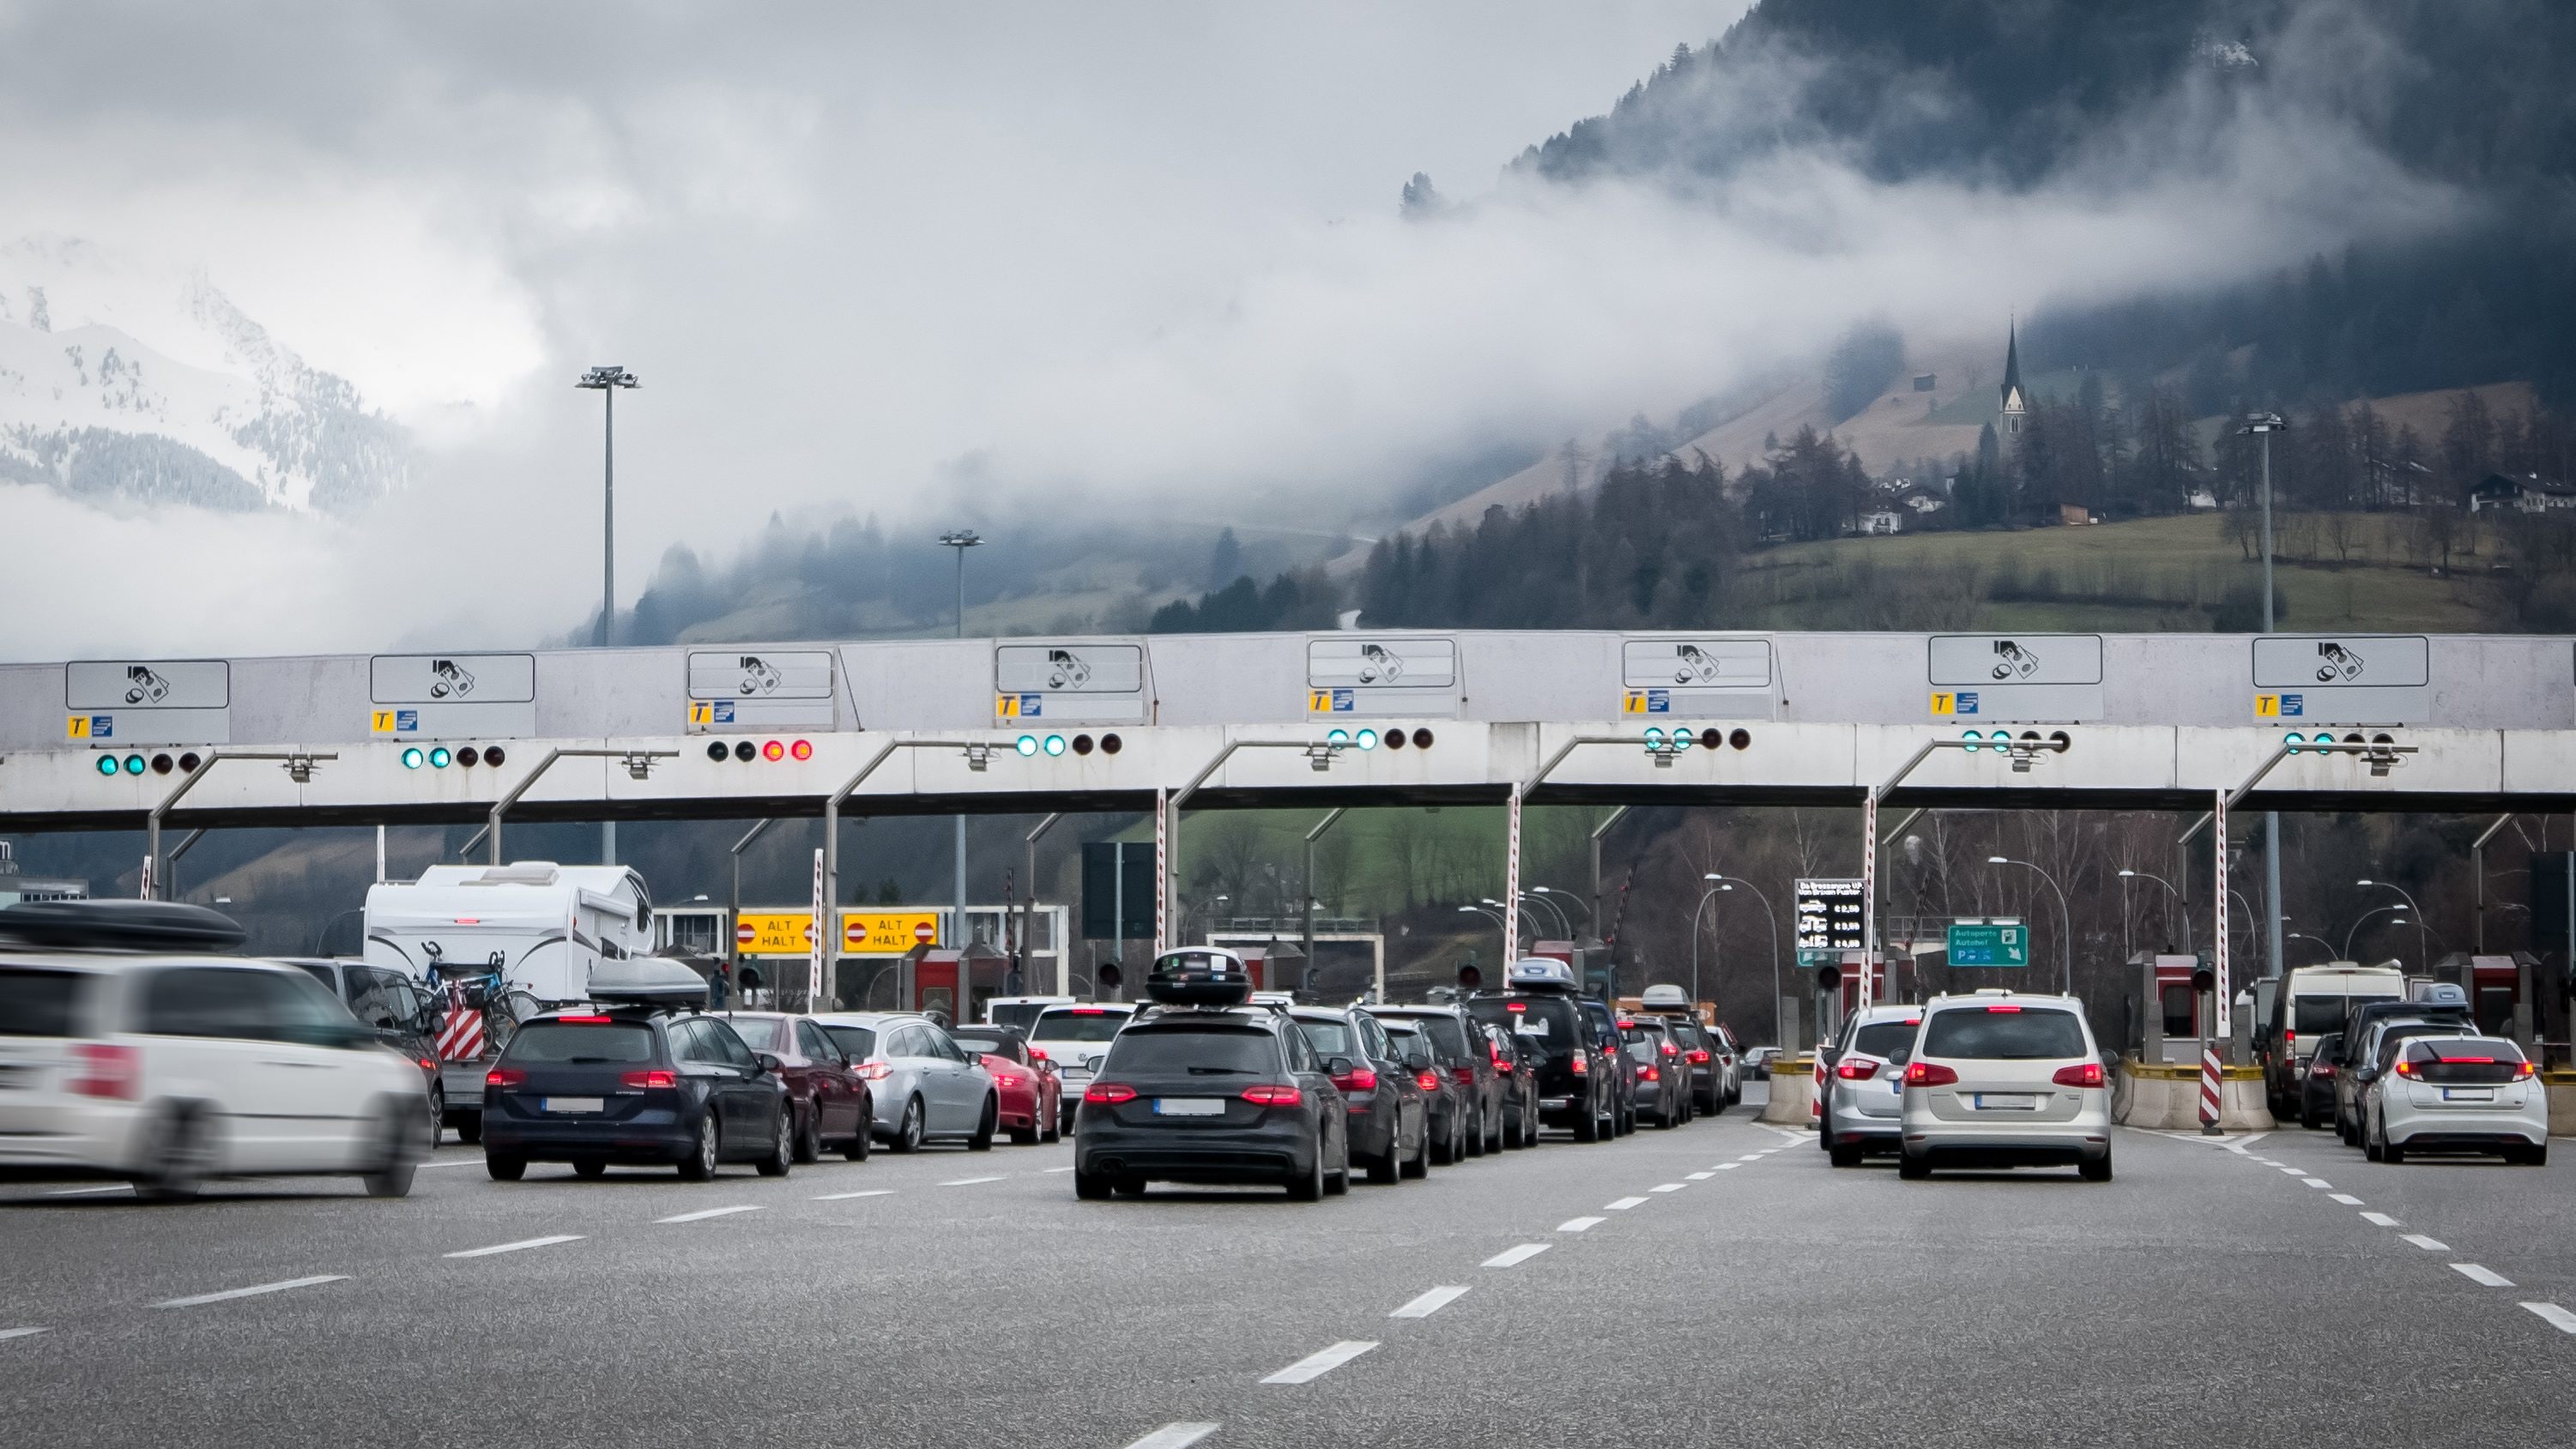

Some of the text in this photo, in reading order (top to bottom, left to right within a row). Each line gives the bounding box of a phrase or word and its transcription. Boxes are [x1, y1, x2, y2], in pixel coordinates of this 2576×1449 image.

[767, 921, 792, 931] ALT
[879, 920, 903, 930] ALT
[762, 936, 796, 946] HALT
[873, 935, 907, 945] HALT
